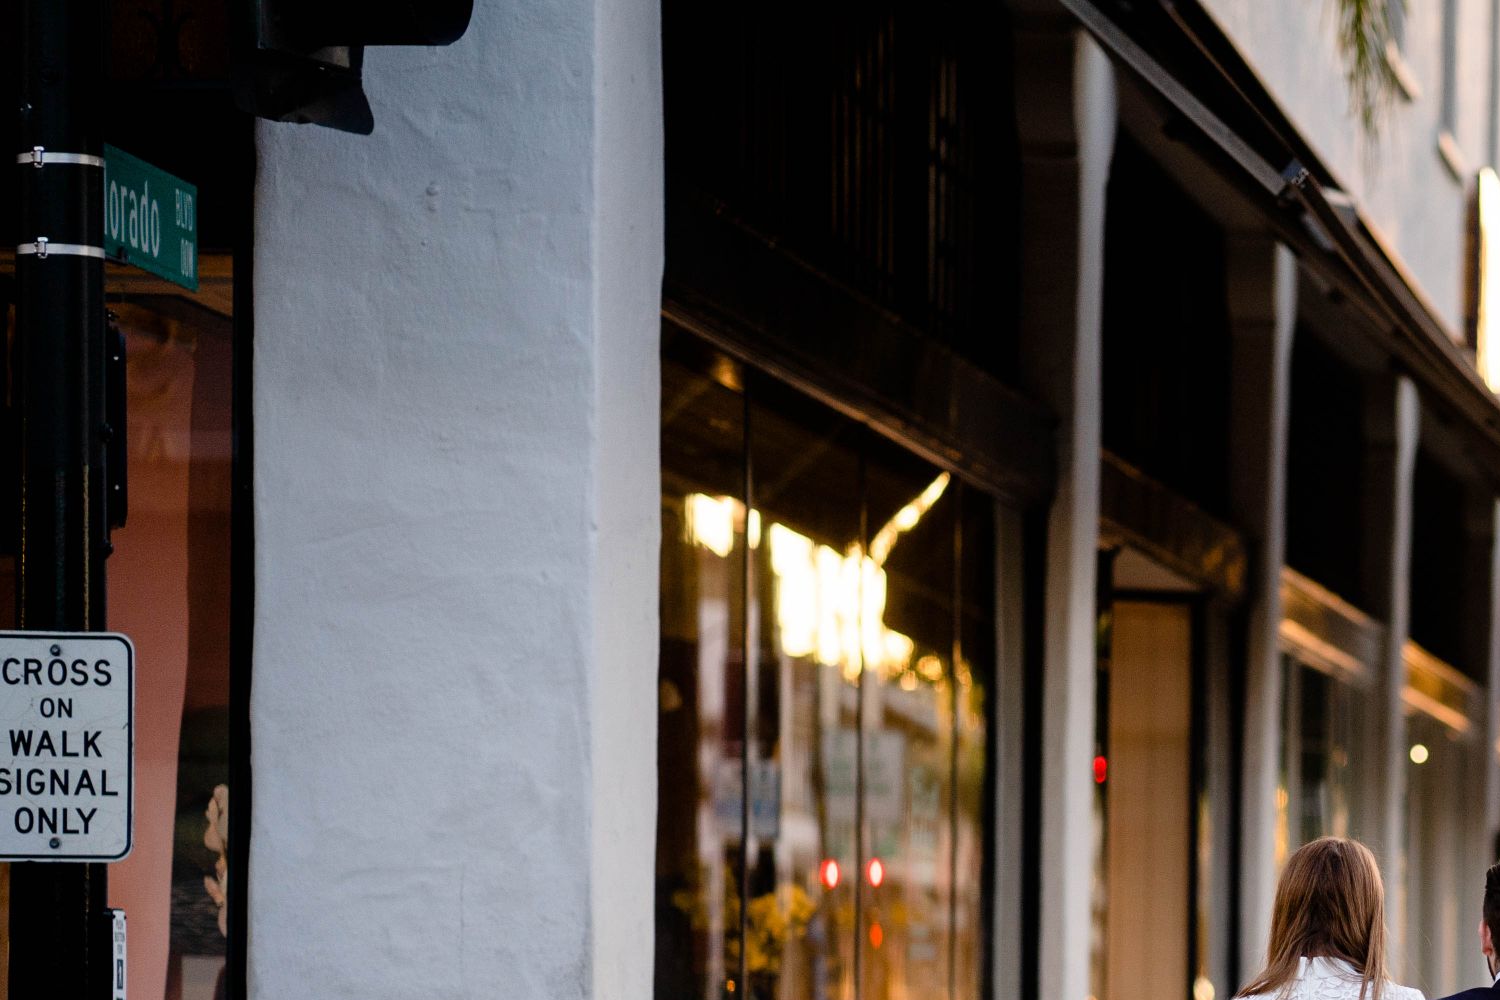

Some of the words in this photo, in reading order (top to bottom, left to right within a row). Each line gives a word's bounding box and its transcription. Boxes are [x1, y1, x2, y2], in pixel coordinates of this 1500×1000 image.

[175, 188, 193, 231] BLVD
[2, 658, 112, 686] CROSS
[40, 697, 73, 718] ON
[9, 729, 103, 758] WALK
[0, 768, 119, 796] SIGNAL
[14, 806, 98, 835] ONLY
